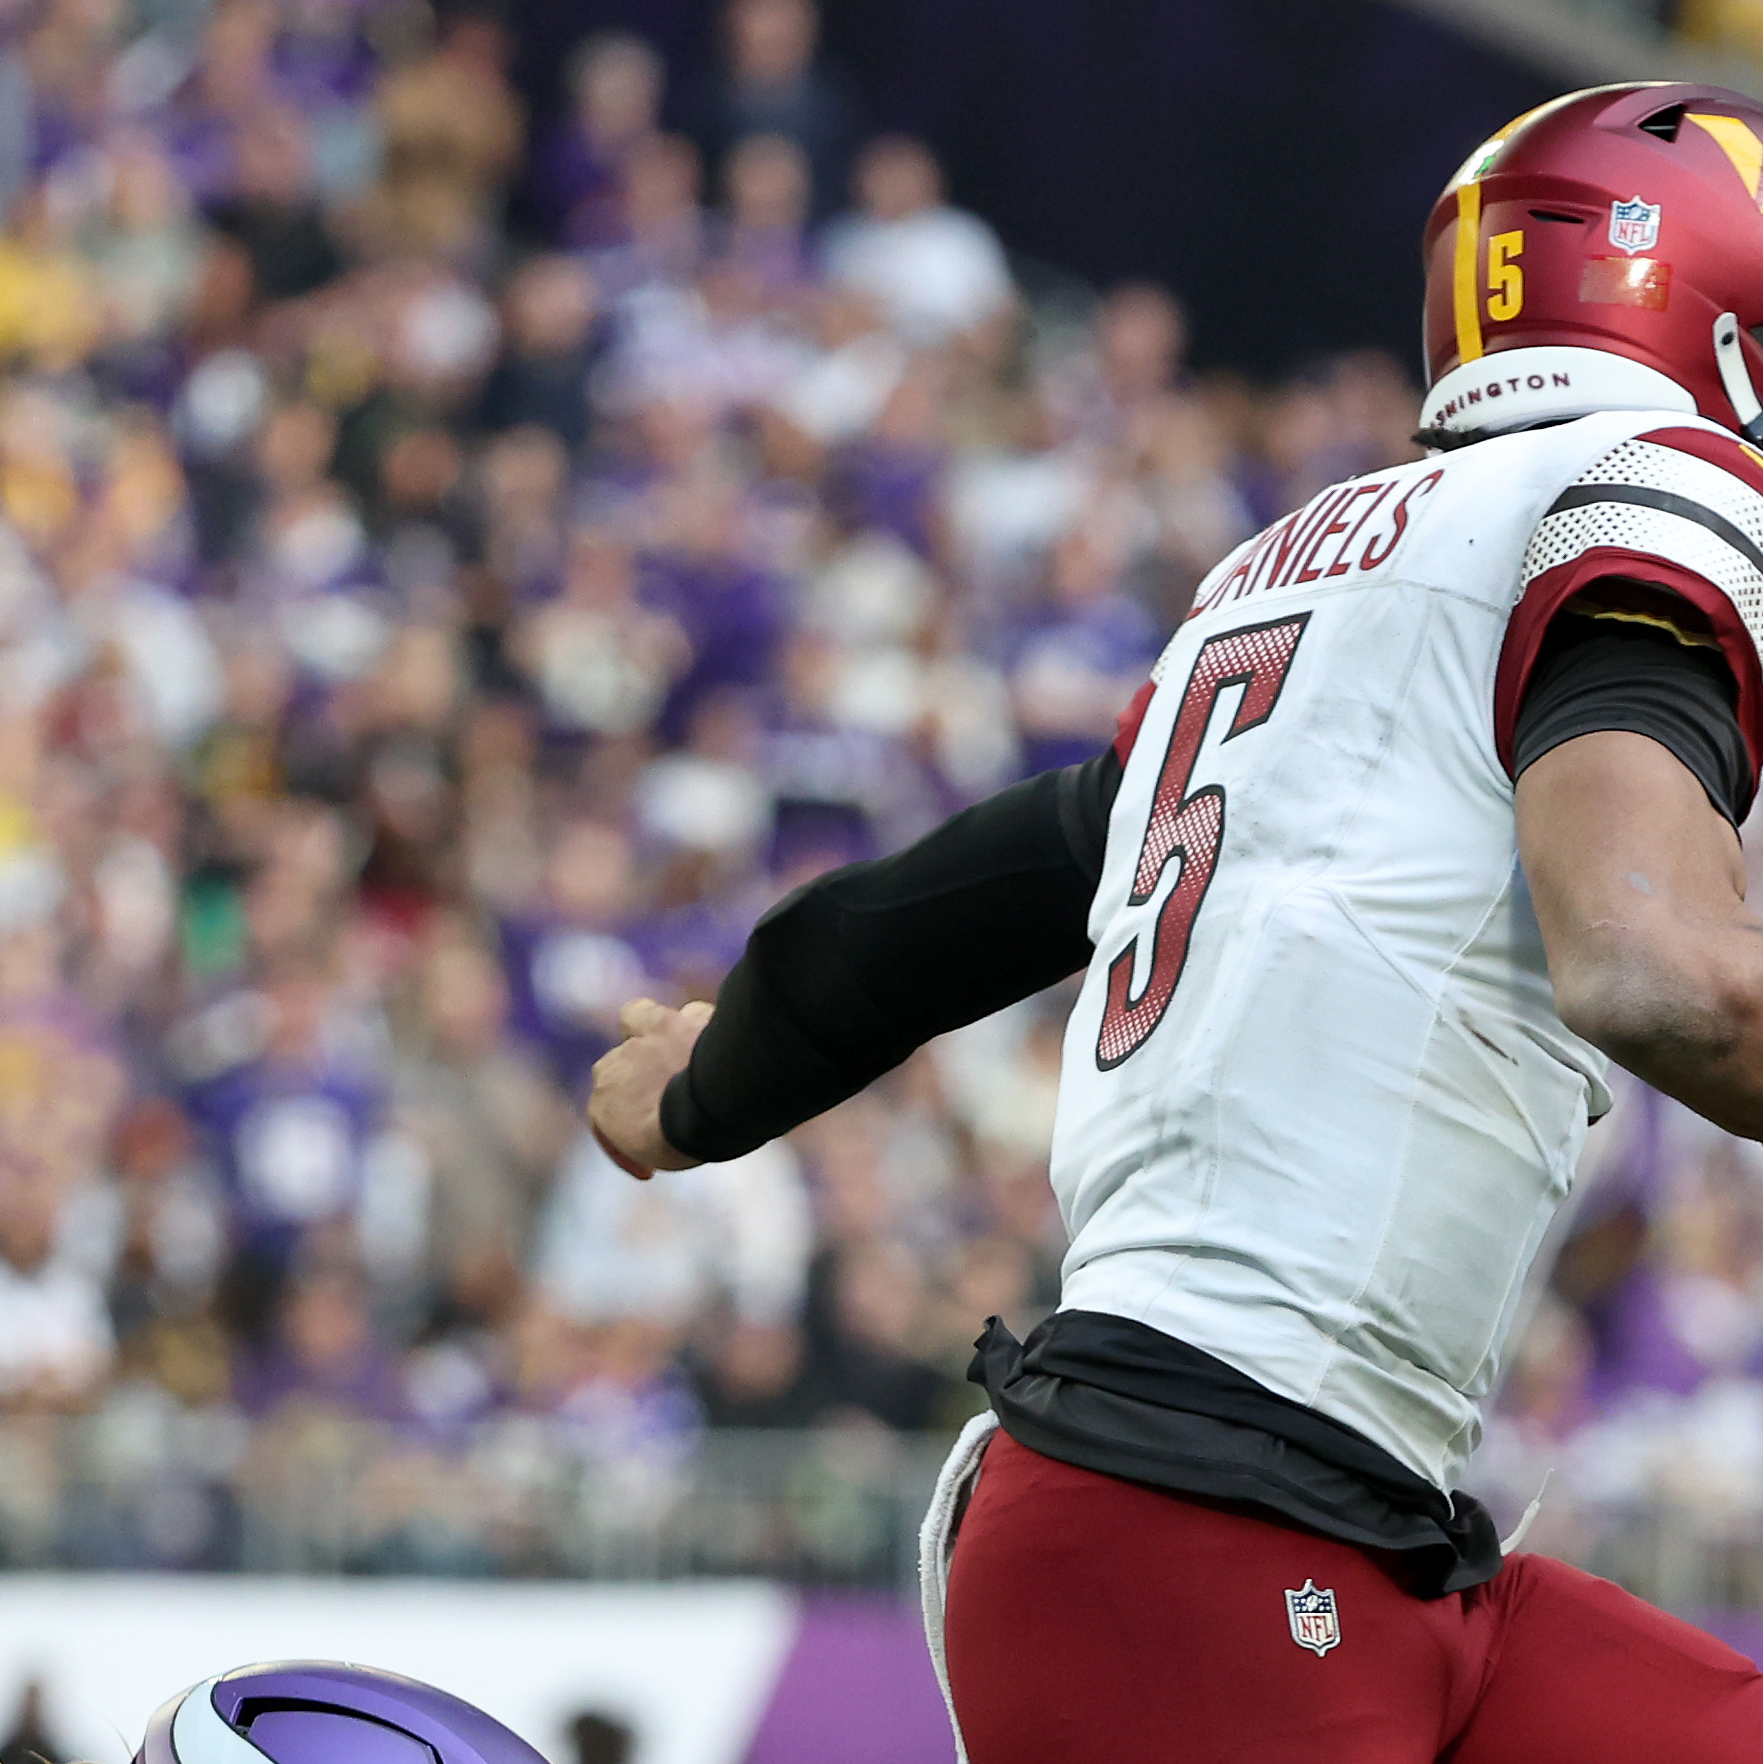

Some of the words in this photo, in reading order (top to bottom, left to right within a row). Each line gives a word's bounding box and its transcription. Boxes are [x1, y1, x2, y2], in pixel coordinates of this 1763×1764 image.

[1617, 221, 1650, 244] NFL
[1486, 230, 1524, 322] 5
[1429, 372, 1571, 429] SHINGTON
[1095, 611, 1314, 1073] 5
[1299, 1615, 1334, 1642] NFL
